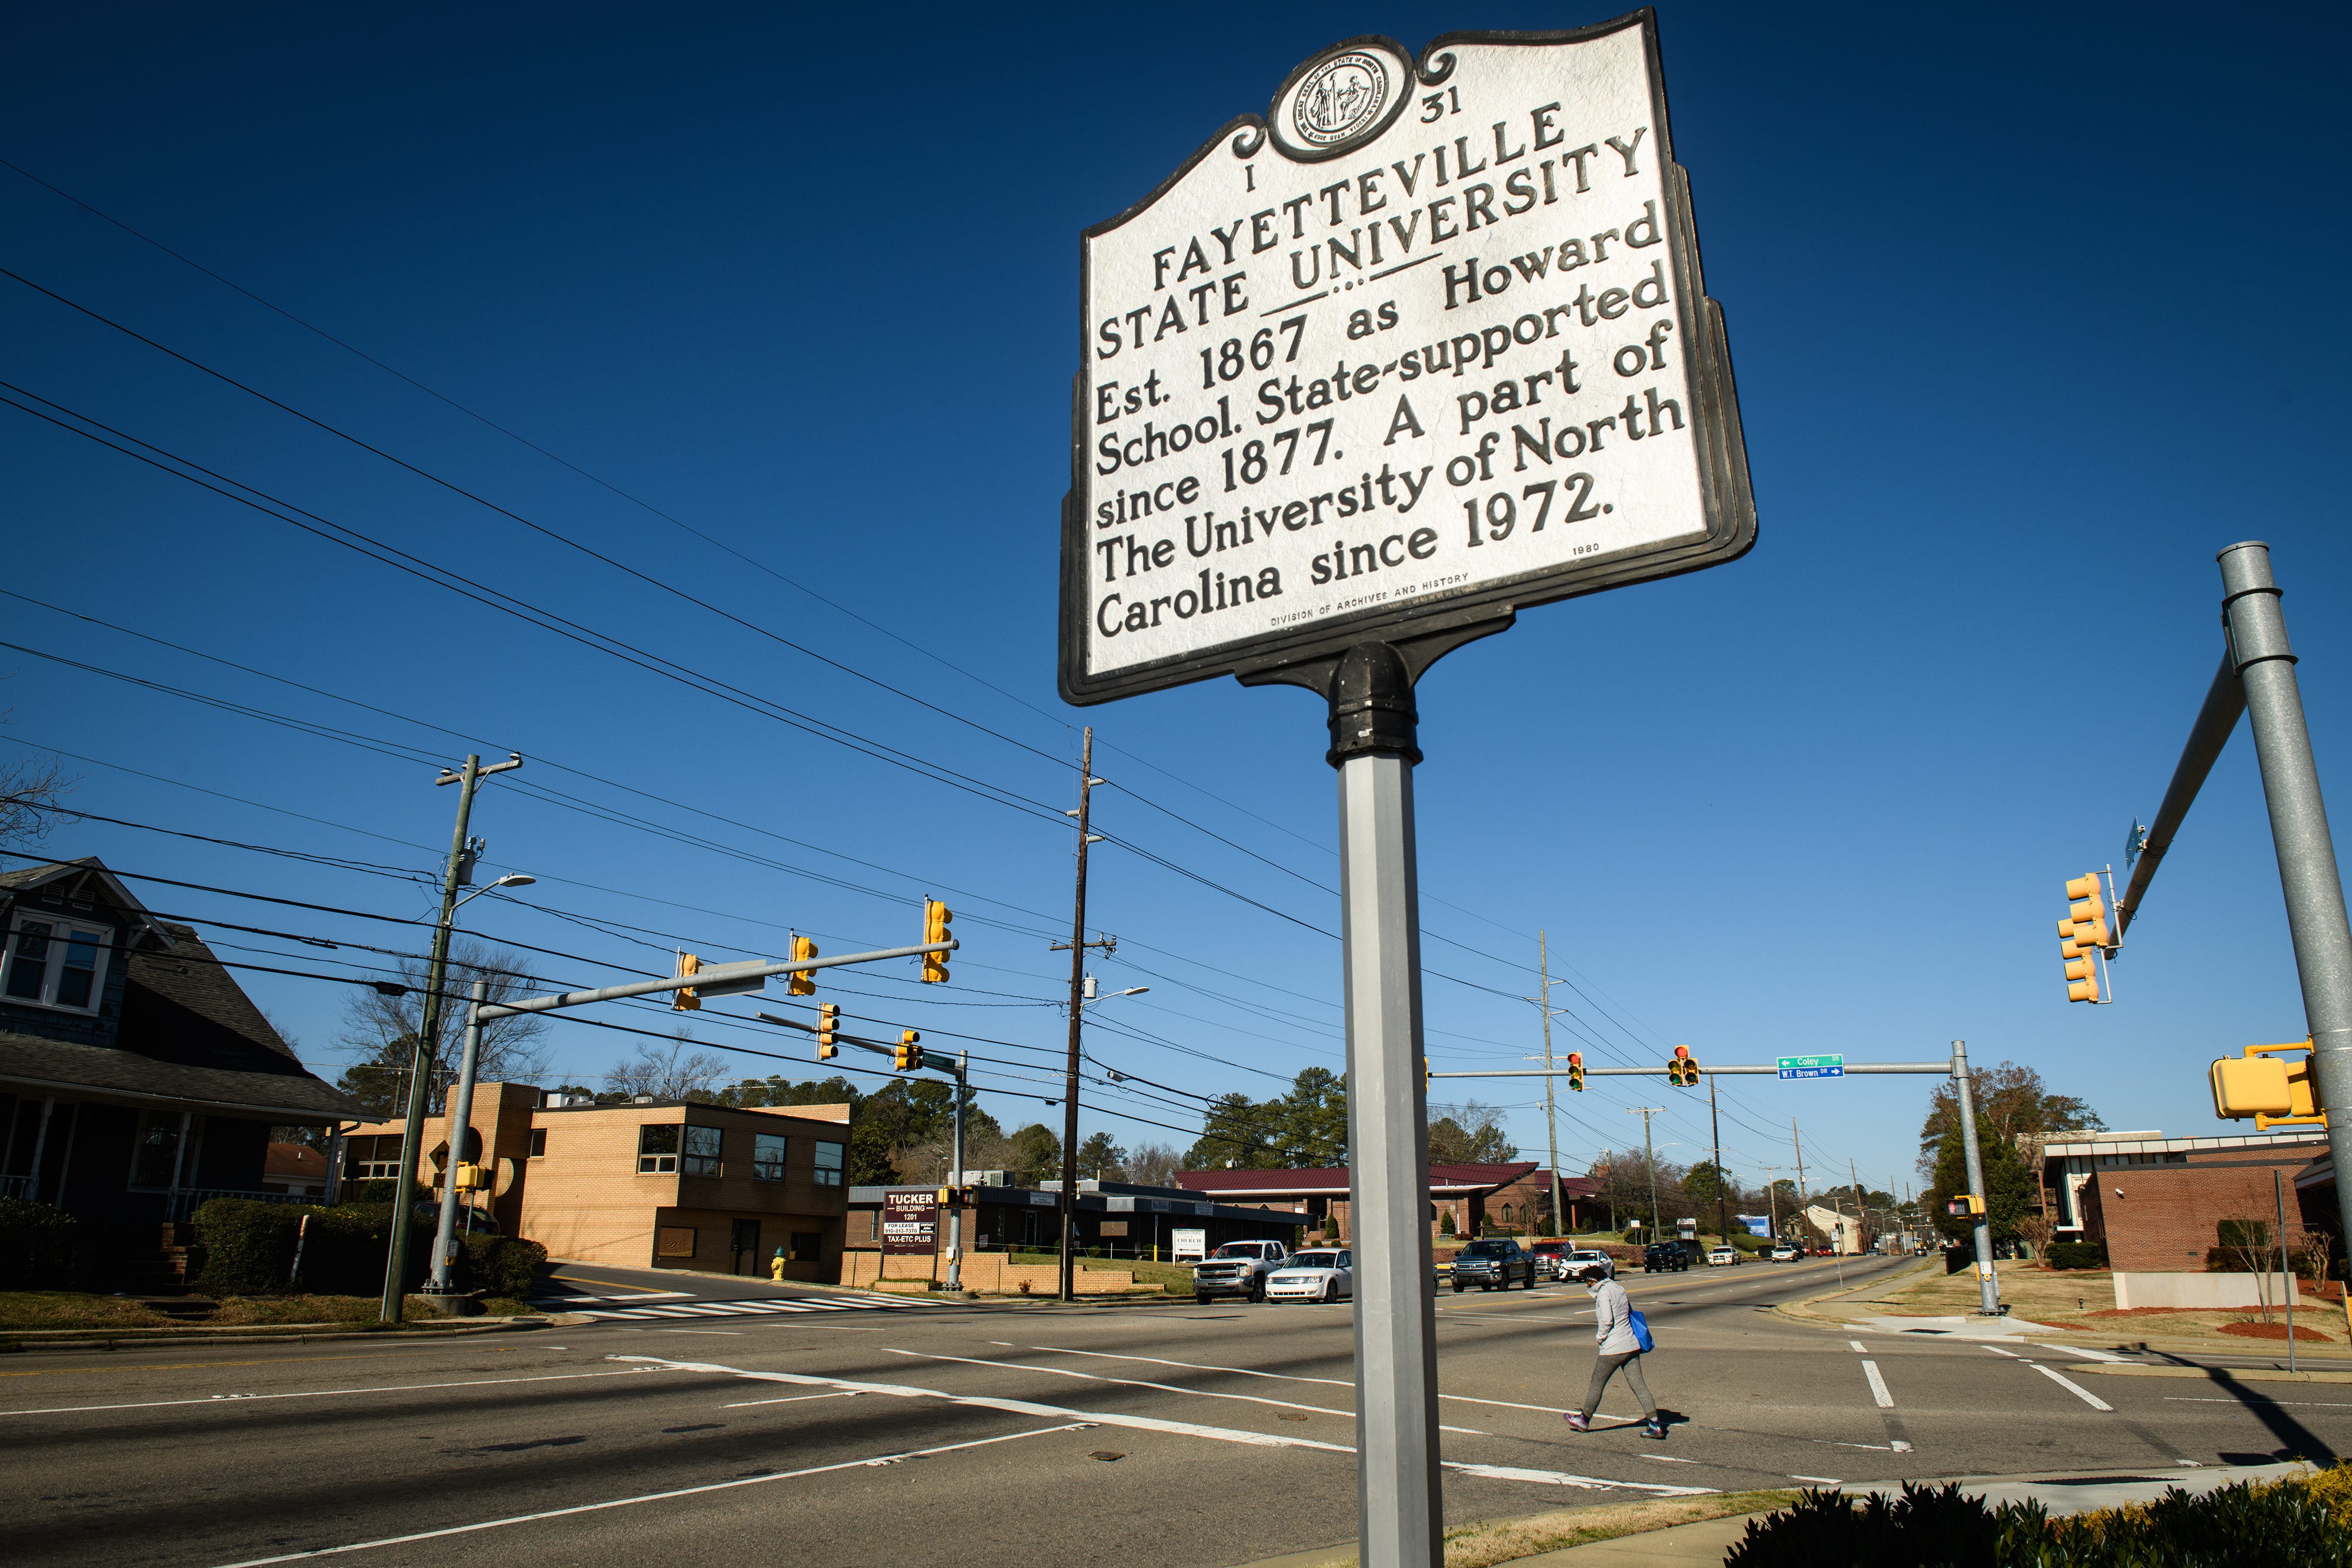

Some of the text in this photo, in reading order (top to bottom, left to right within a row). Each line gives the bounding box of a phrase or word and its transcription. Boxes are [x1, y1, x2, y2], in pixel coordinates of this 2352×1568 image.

[1321, 65, 1331, 73] THE
[1334, 56, 1353, 66] STATE
[1362, 59, 1379, 74] NORTH
[1421, 86, 1461, 123] 31
[1097, 127, 1647, 360] STATE UNIVERSITY
[1153, 102, 1564, 291] FAYETTEVILLE
[1097, 200, 1662, 425] Est. 1867 as Howard
[1097, 260, 1669, 476] School. State-supported
[1097, 319, 1673, 530] since 1877. A part of
[1097, 387, 1685, 582] The University of North
[1097, 473, 1613, 637] Carolina since 1972.
[1271, 573, 1468, 626] DIVISION OF ARCHIVES AND HISTORY
[1572, 543, 1599, 556] 1980
[1797, 1058, 1819, 1066] Coley
[888, 1194, 933, 1204] TUCKER
